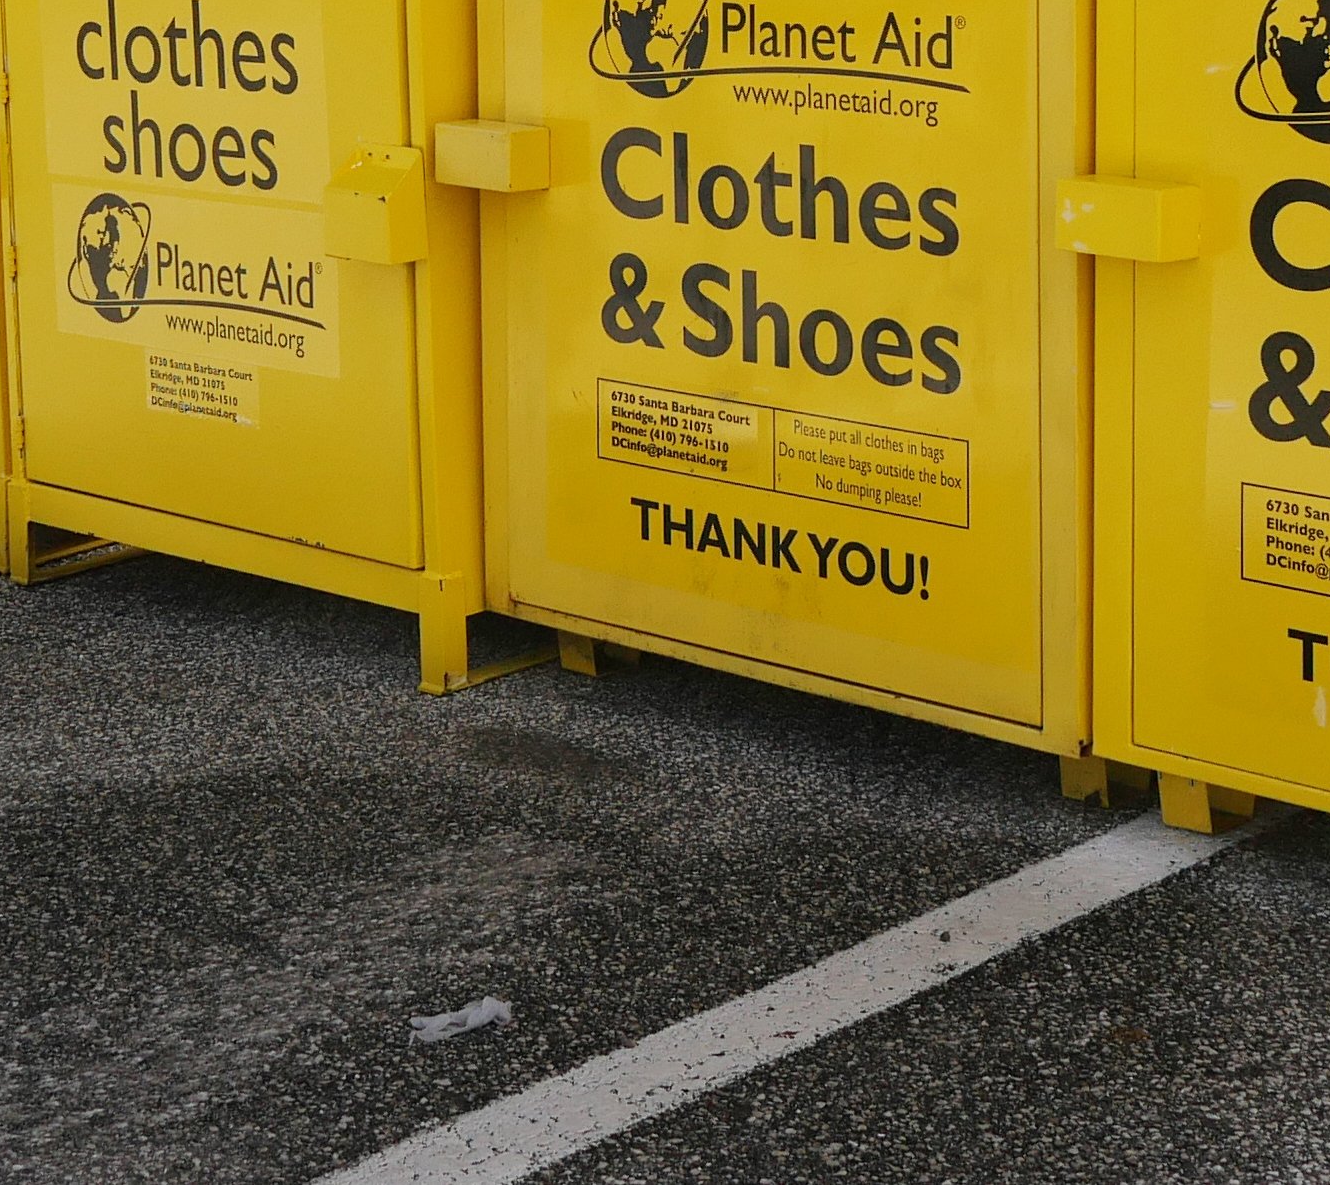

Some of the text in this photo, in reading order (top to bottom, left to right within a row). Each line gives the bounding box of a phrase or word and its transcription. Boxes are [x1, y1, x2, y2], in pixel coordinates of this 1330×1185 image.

[723, 2, 856, 62] Planet
[733, 83, 938, 127] www.planetaid.org
[103, 90, 277, 190] shoes
[601, 127, 959, 256] Clothes
[157, 242, 248, 299] Planet
[166, 315, 305, 358] www.planetaid.org
[602, 253, 960, 394] & Shoes
[611, 391, 750, 426] 6730 Santa Barbara Court
[612, 406, 712, 434] Elkridge, MD 21075
[612, 421, 729, 453] Phone: (410) 796-1510
[612, 437, 728, 472] DCinfo@planetaid.org
[1266, 499, 1299, 516] 6730
[630, 497, 930, 601] THANK YOU!
[1266, 535, 1314, 556] Phone:
[1267, 517, 1329, 542] Elkridge,
